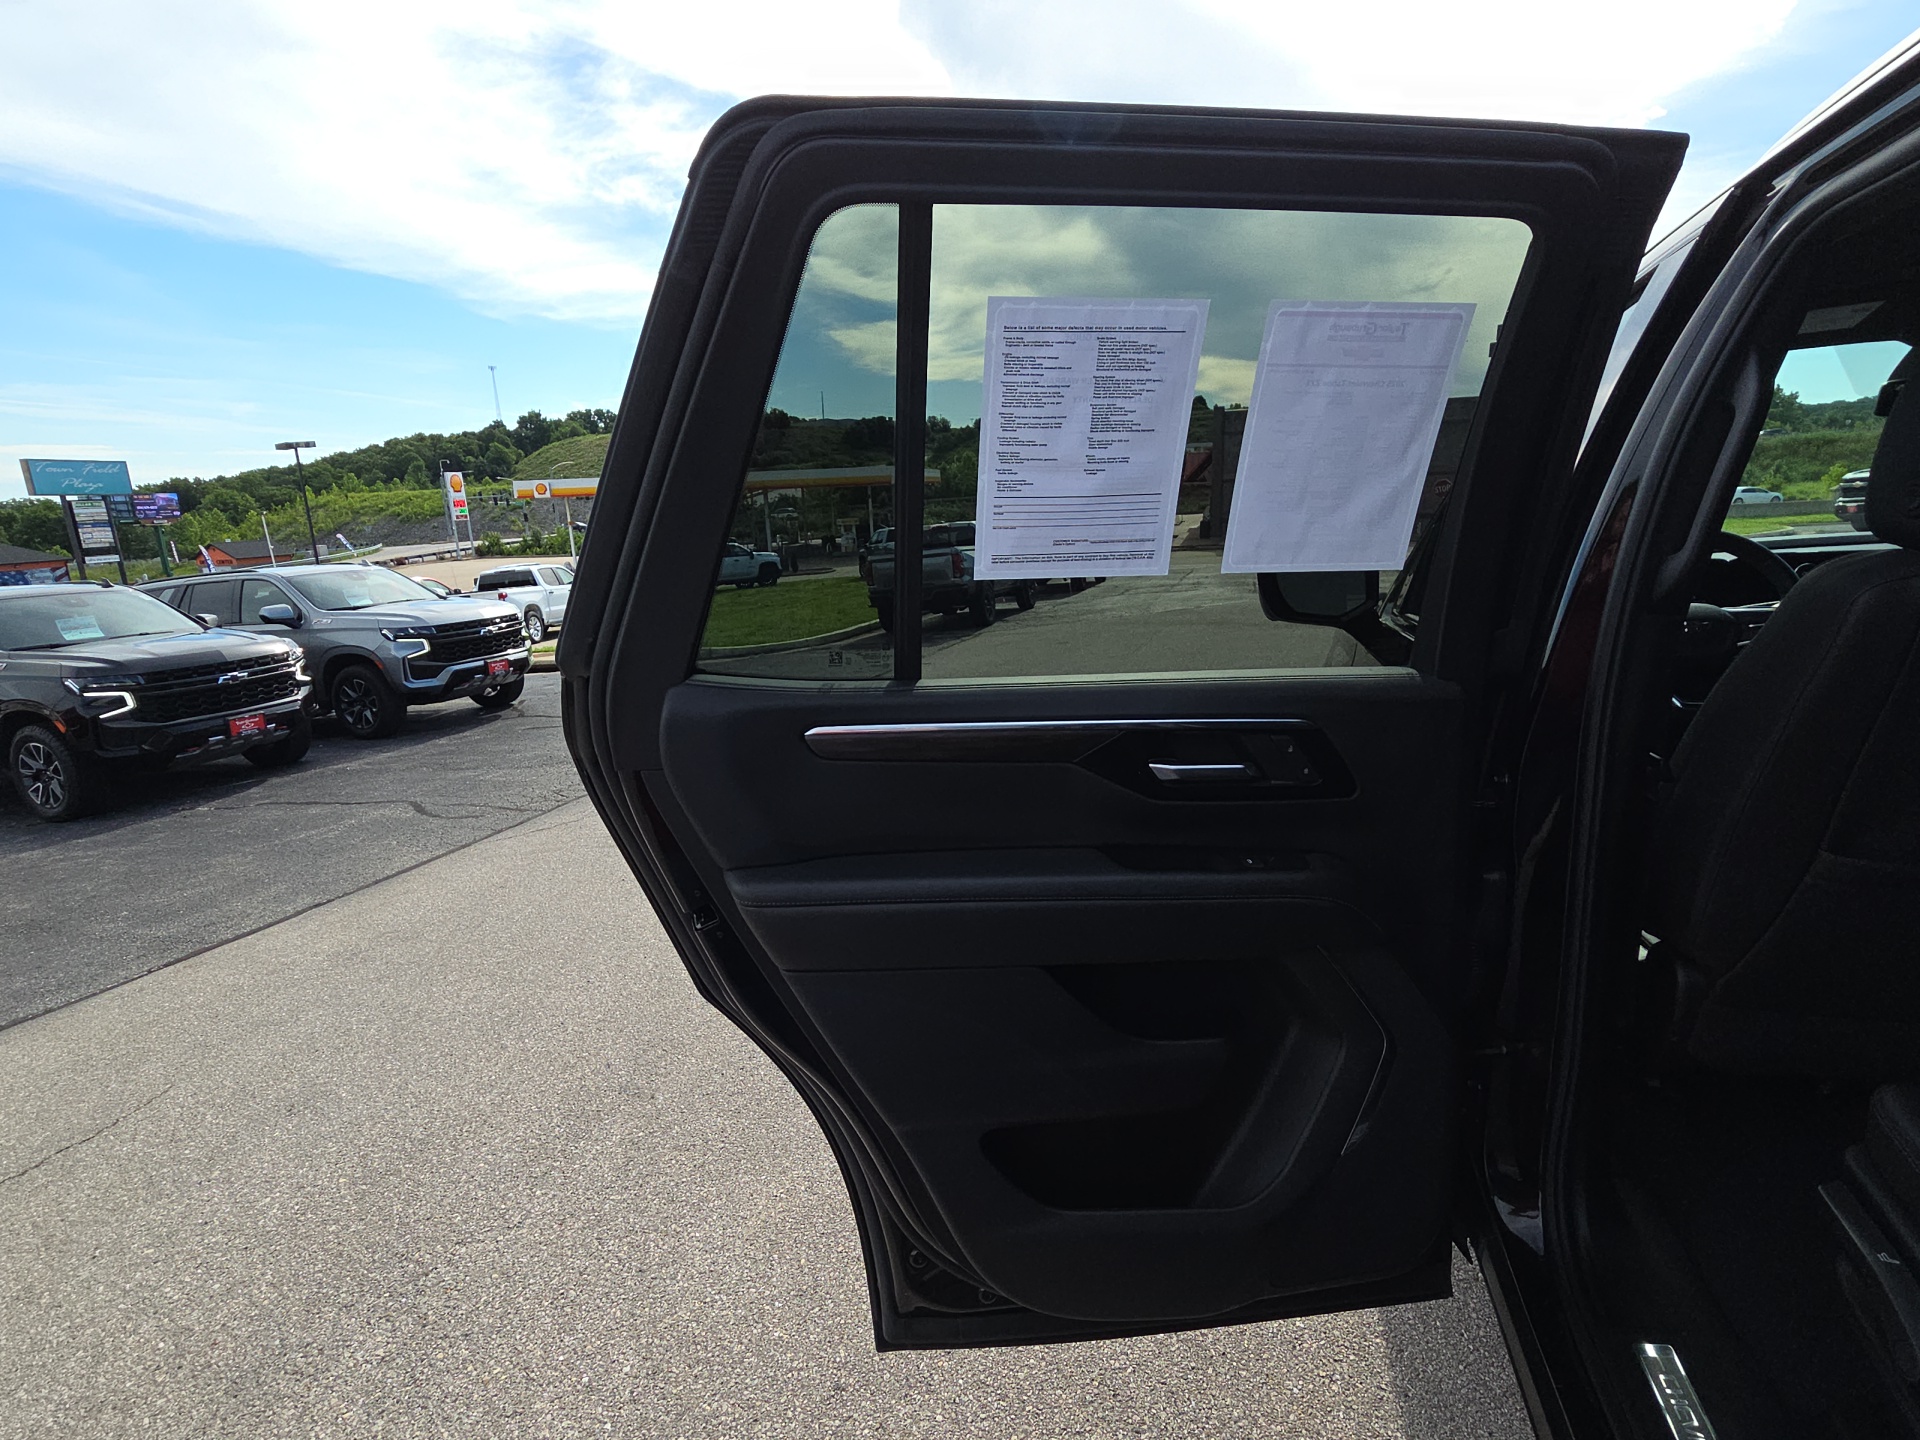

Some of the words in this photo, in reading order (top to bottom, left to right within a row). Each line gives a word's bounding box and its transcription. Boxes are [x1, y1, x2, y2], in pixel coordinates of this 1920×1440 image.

[35, 461, 75, 473] Town
[81, 462, 121, 475] Field
[1434, 483, 1451, 493] STOP
